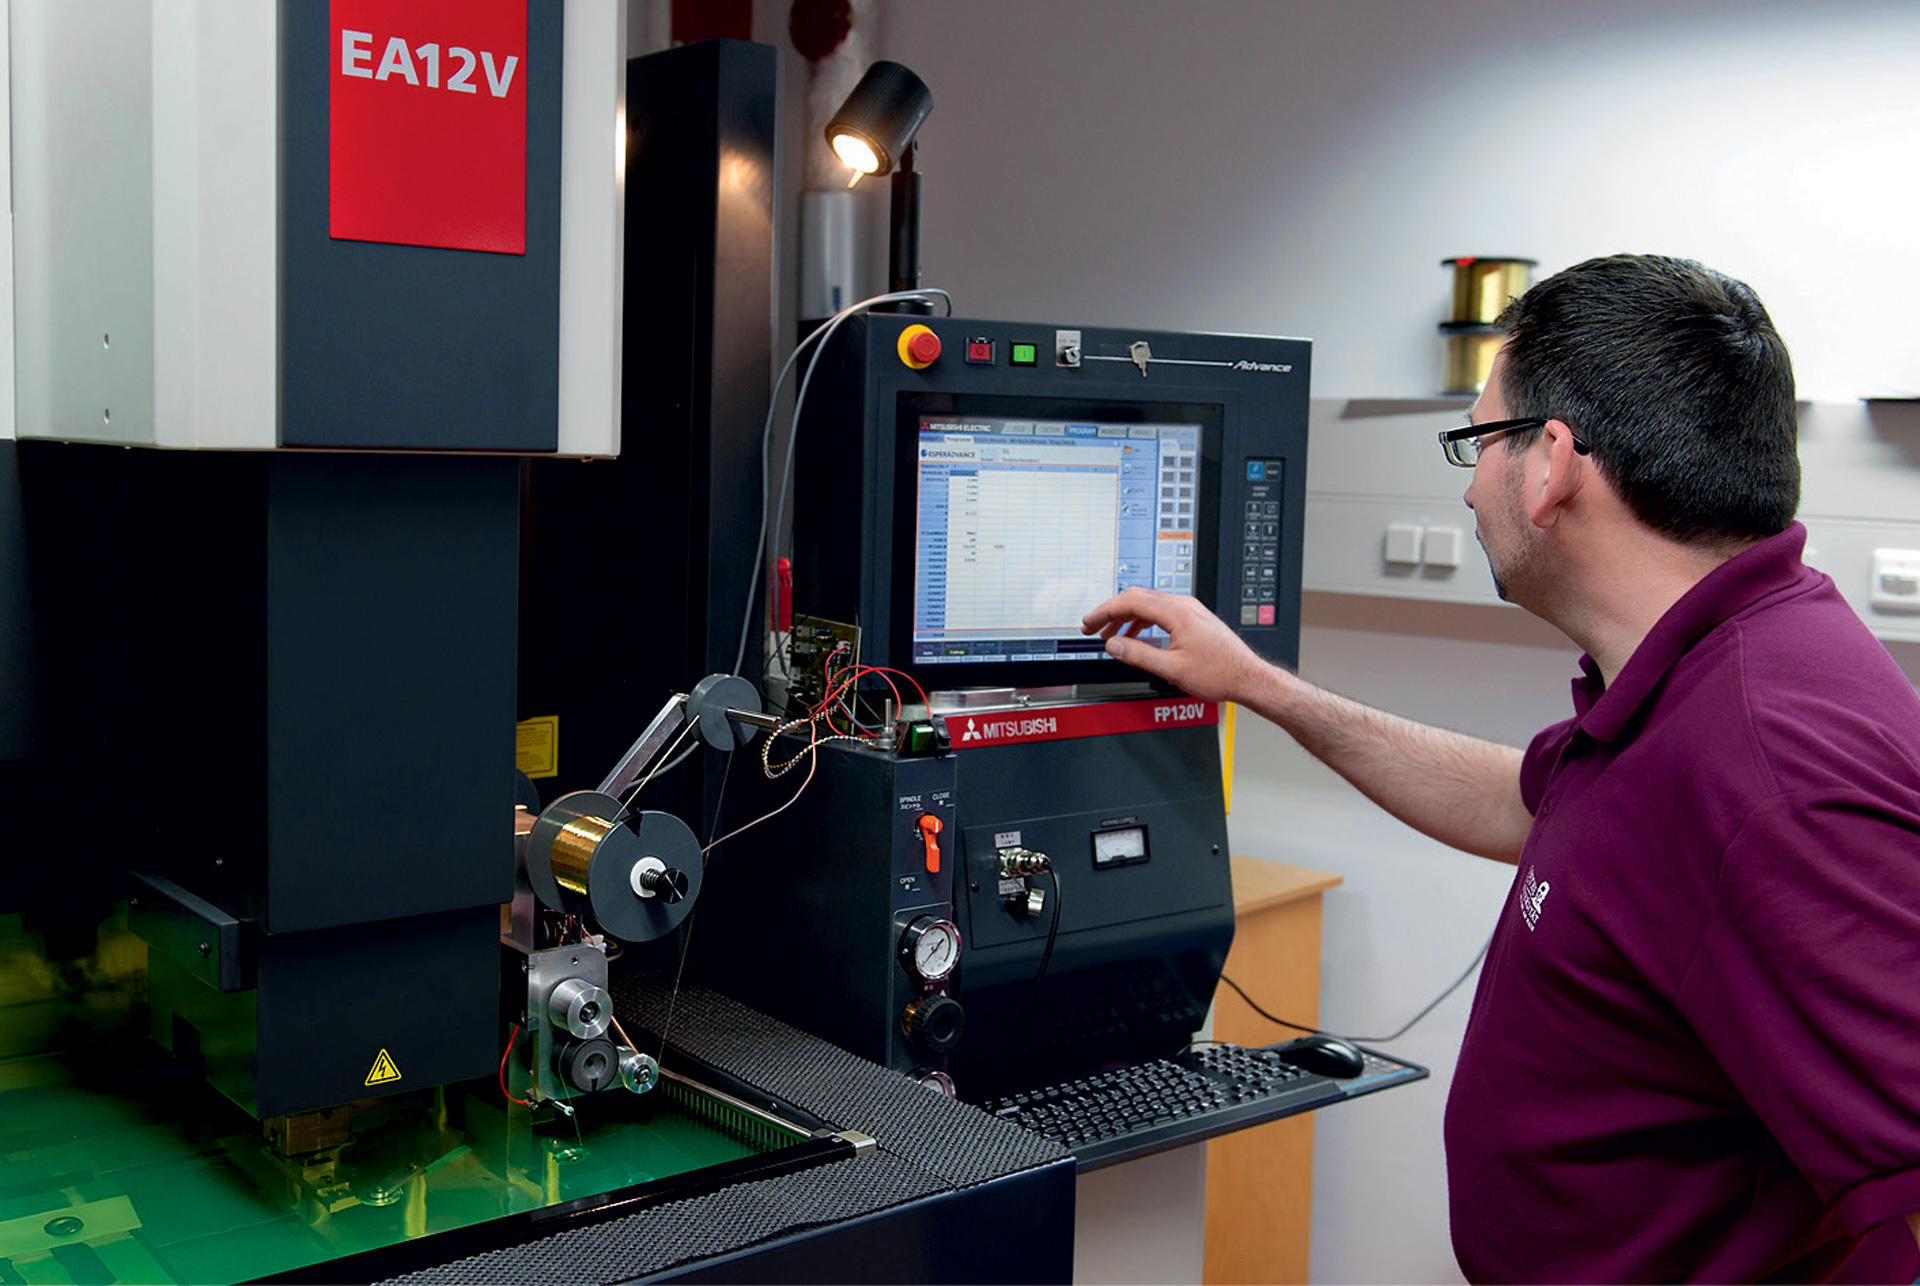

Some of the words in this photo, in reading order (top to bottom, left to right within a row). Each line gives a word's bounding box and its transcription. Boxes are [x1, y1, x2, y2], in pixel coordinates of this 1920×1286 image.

[342, 29, 519, 98] EA12V
[1232, 360, 1292, 373] Advance
[1154, 703, 1205, 723] FP120V
[983, 717, 1057, 739] MITSUBISHI
[932, 792, 950, 800] CLOSE
